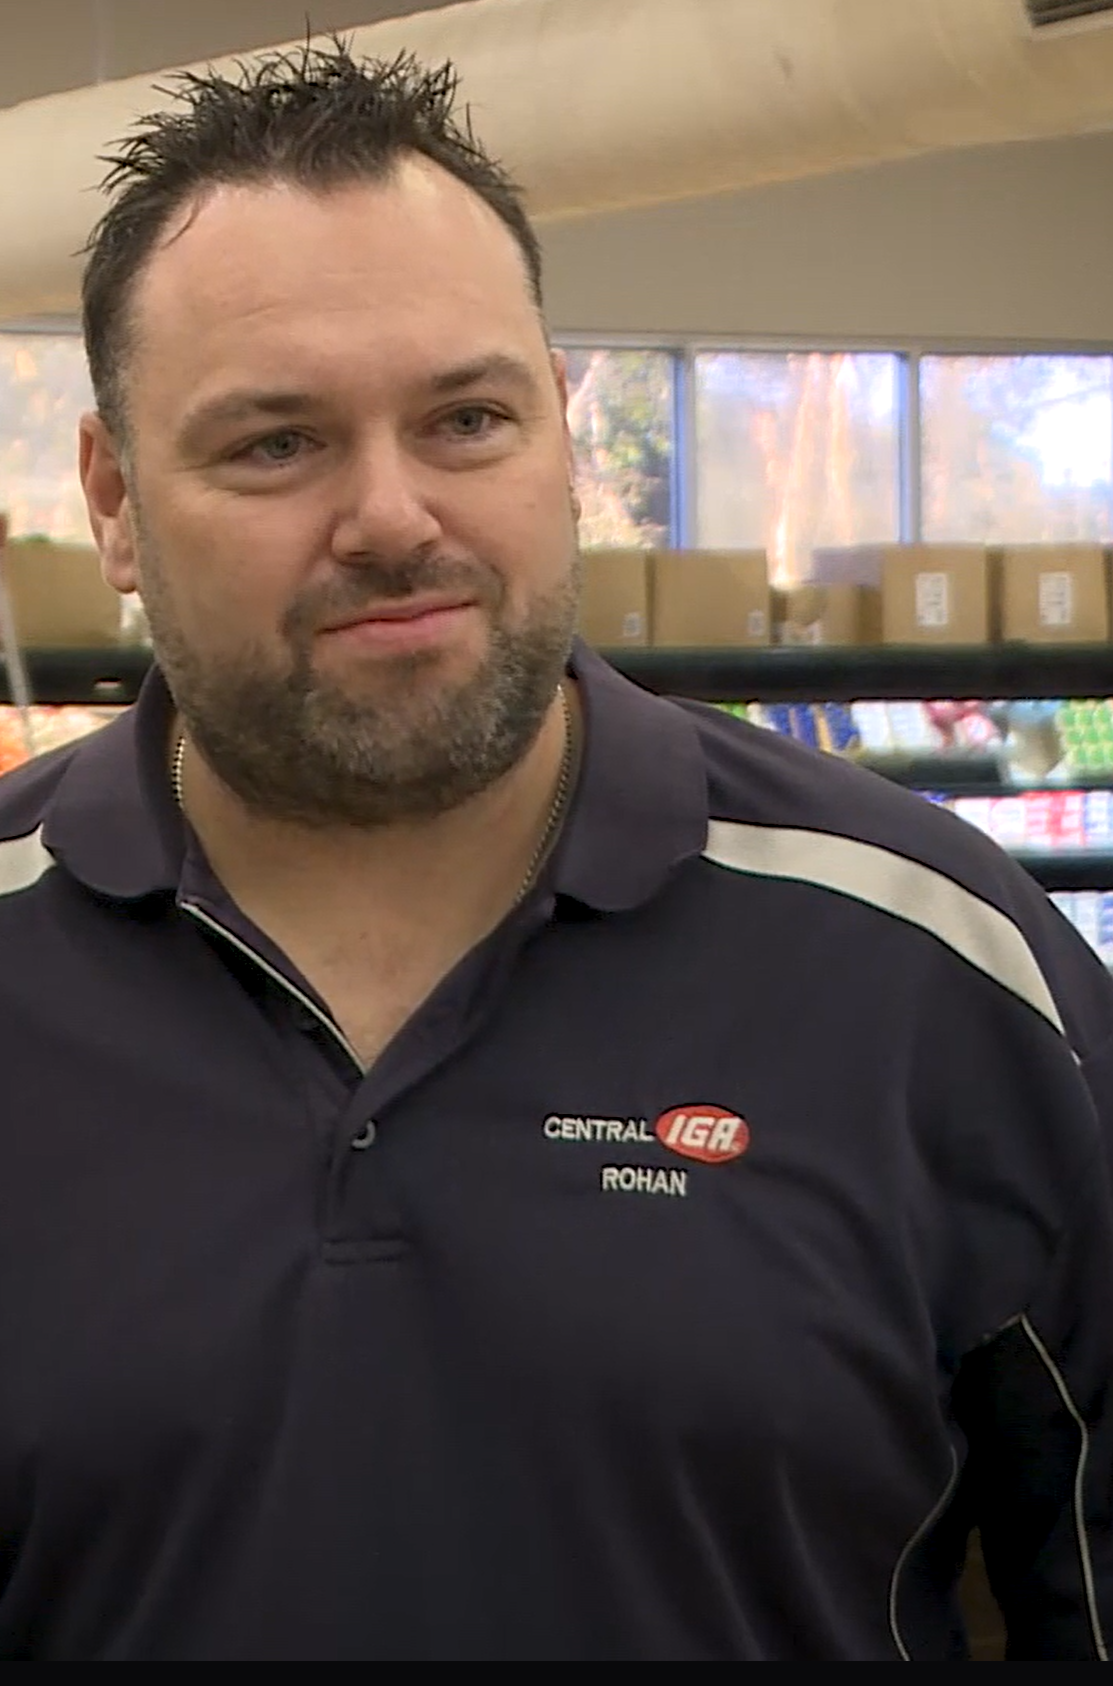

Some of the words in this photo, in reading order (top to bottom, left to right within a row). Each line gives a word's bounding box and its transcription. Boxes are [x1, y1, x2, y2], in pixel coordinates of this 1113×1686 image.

[544, 1116, 655, 1142] CENTRAL
[665, 1114, 743, 1152] IGA
[601, 1166, 687, 1197] ROHAN
